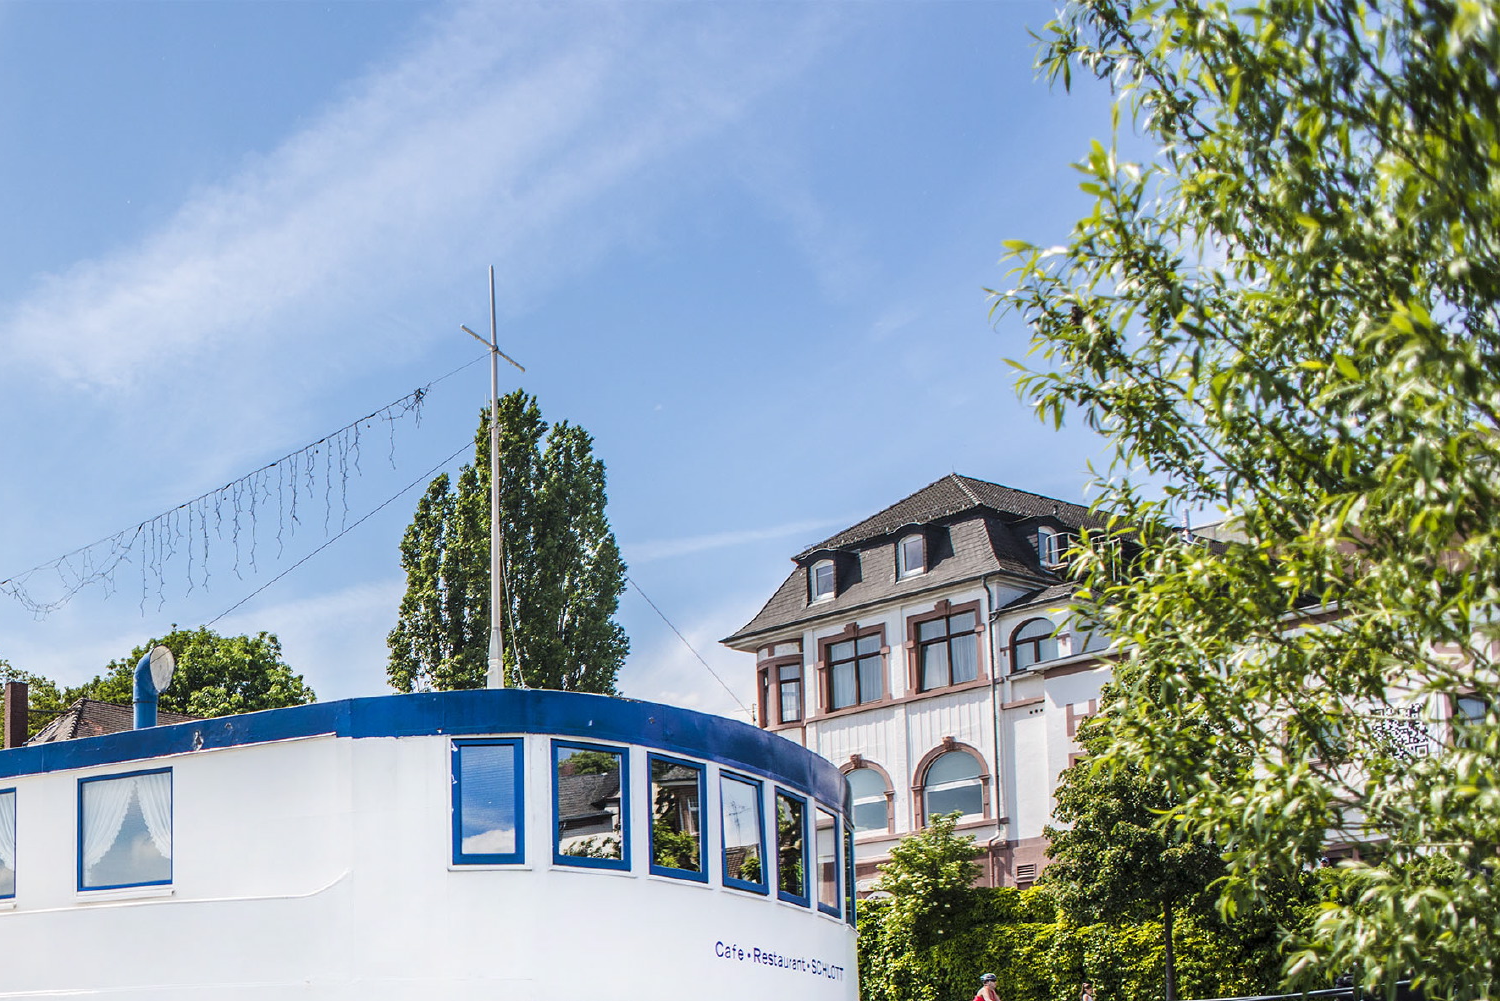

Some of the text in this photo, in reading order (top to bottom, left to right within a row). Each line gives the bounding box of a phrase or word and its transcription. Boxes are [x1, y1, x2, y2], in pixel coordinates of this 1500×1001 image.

[715, 940, 844, 982] Cafe Restaurant SCHLOTT
